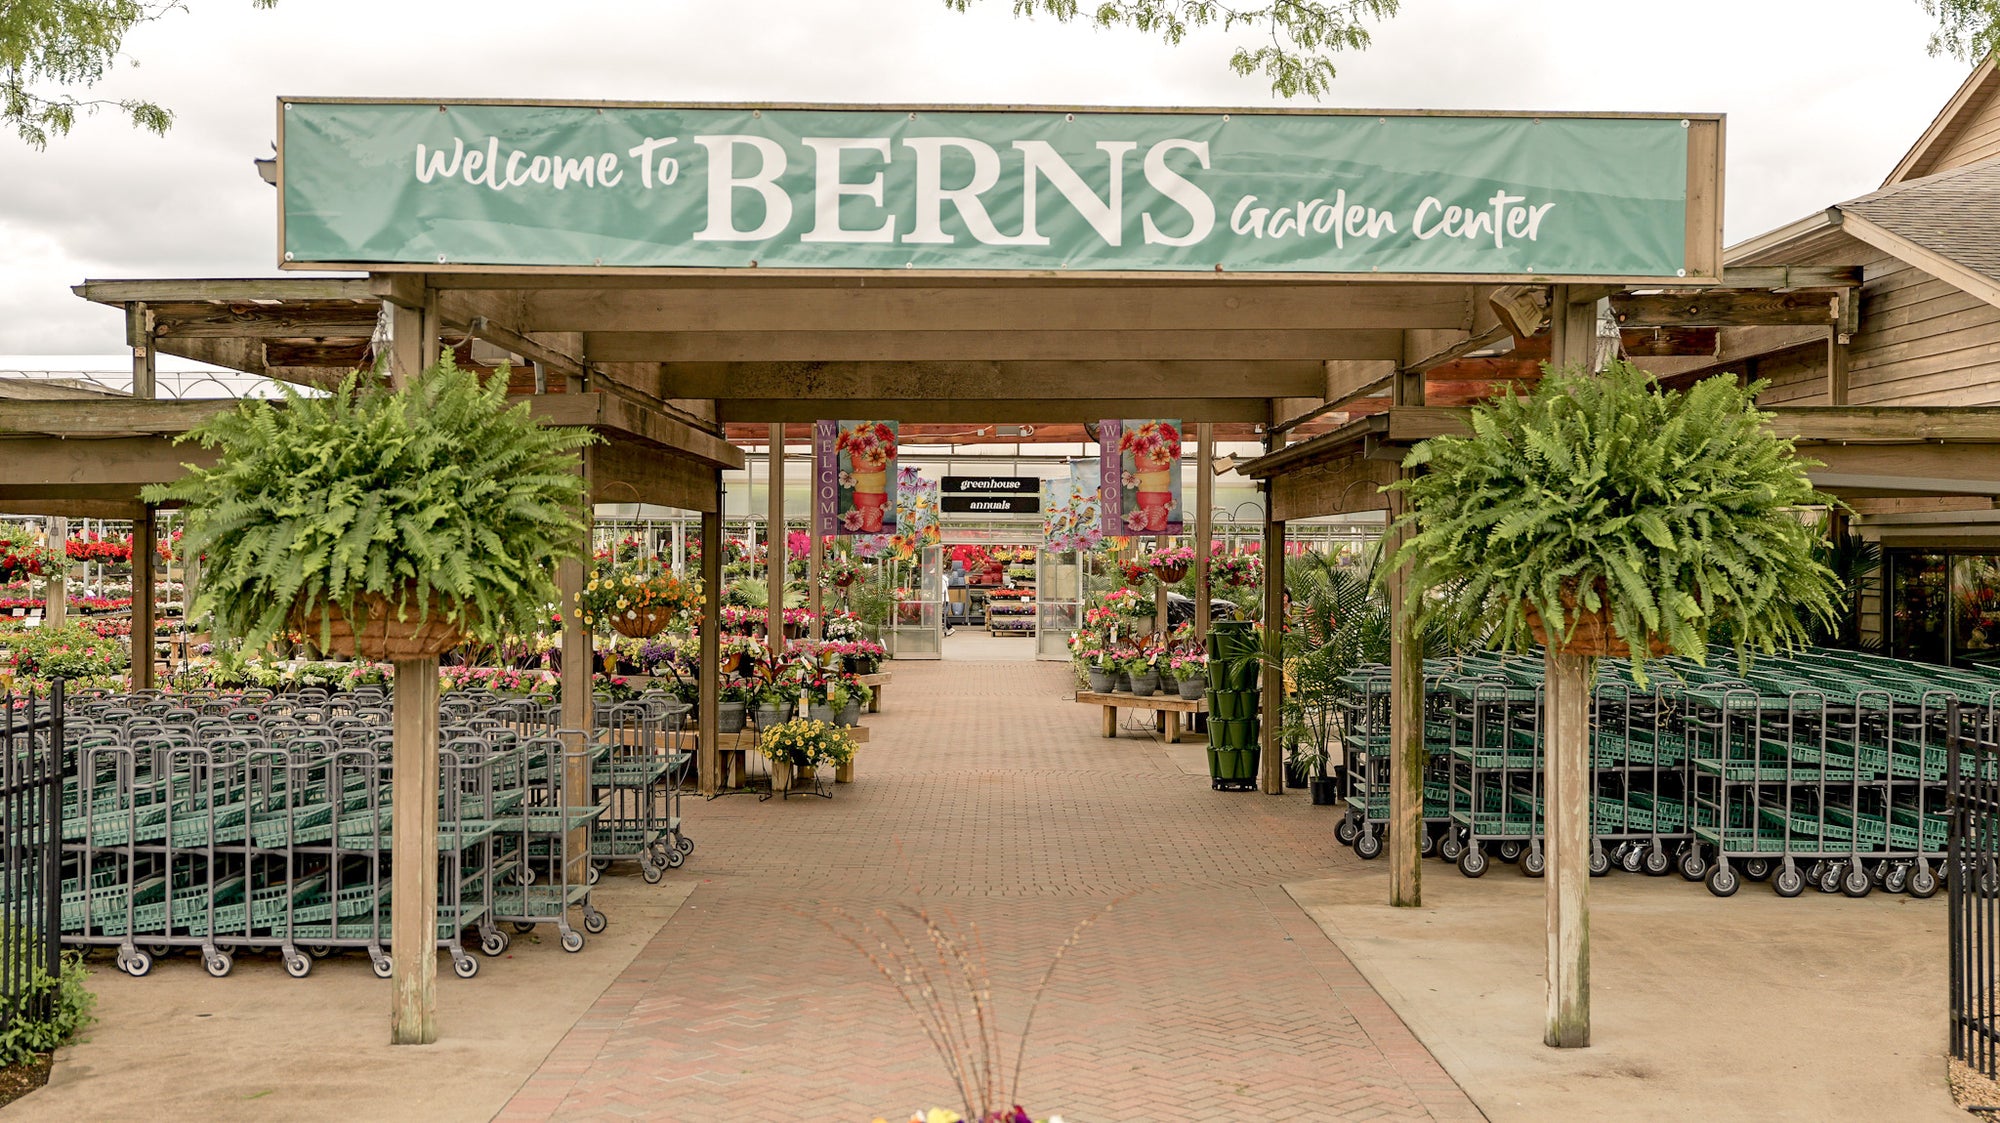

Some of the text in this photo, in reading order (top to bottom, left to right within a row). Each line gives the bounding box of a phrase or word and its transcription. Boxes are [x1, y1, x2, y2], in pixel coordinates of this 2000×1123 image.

[415, 135, 1556, 249] Welcome To BERNS Garden Center
[819, 424, 835, 530] WELCOME
[960, 479, 1021, 490] greenhouse
[969, 500, 1011, 510] annuals
[1103, 424, 1118, 531] WELCOME
